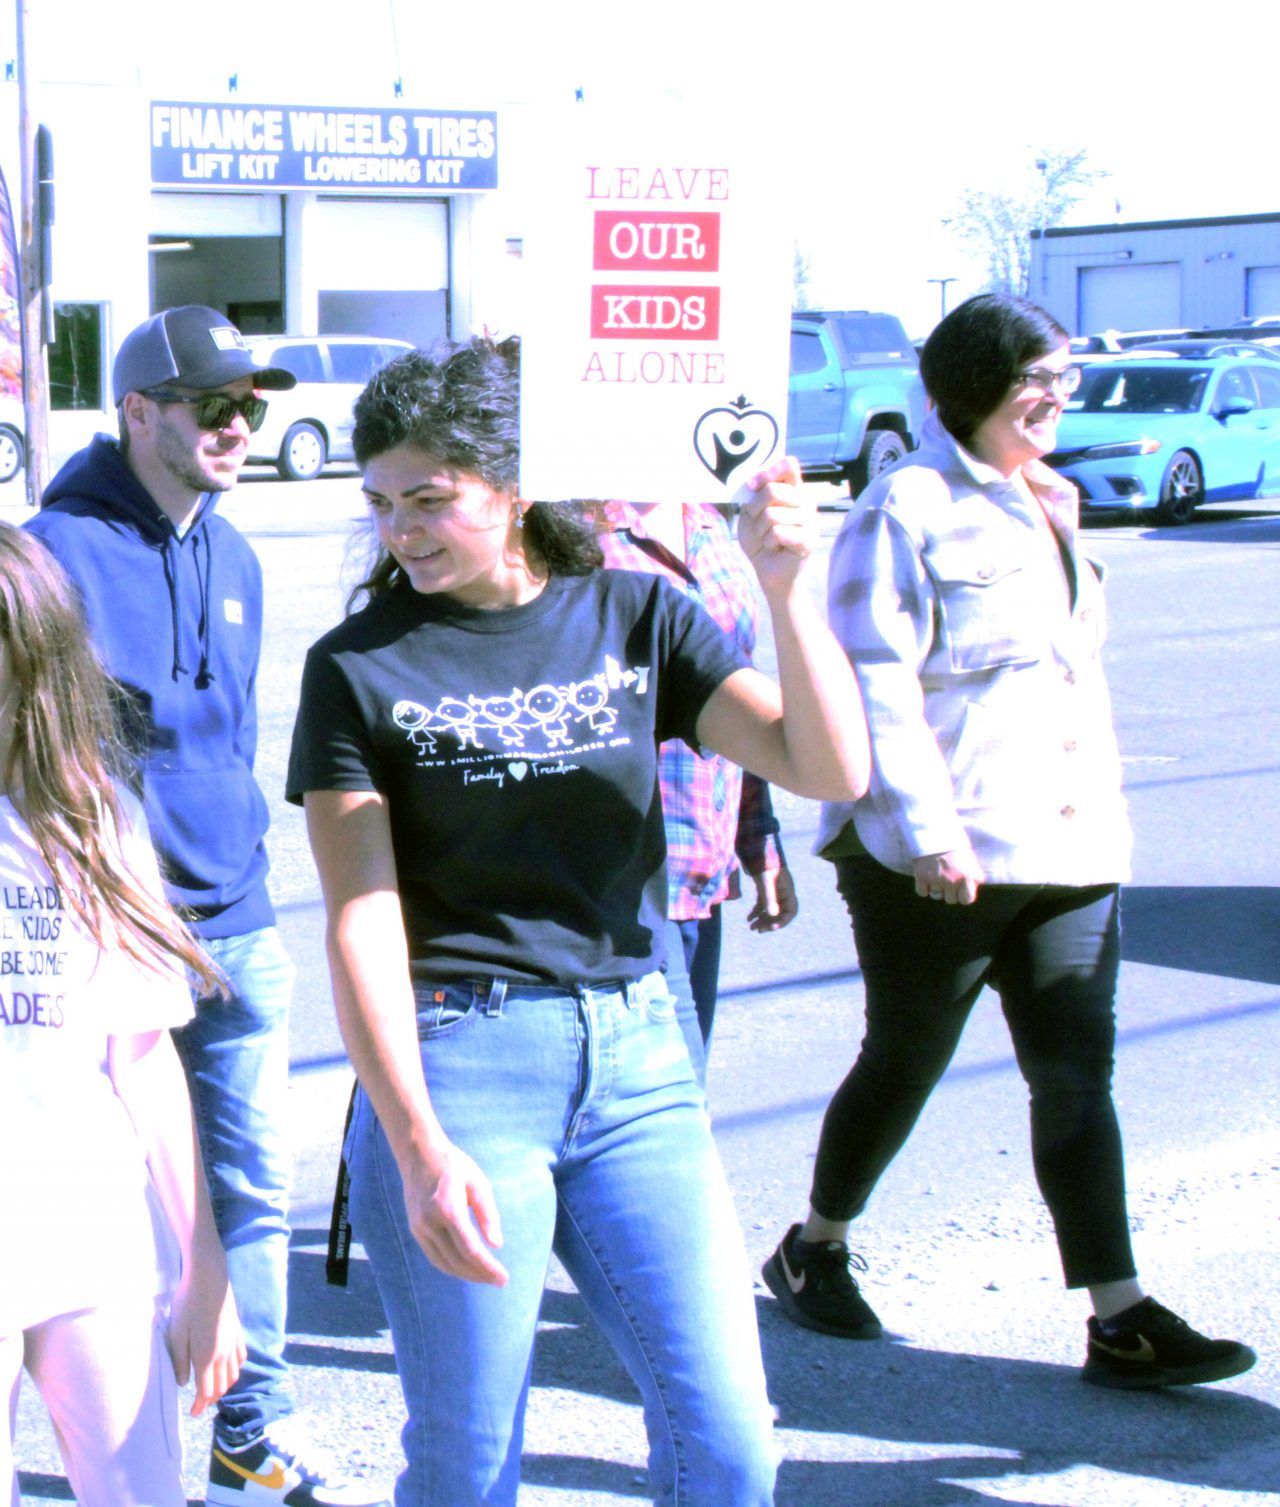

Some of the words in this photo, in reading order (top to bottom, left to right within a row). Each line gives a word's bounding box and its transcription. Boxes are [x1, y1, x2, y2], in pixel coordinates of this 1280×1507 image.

[152, 106, 283, 151] FINANCE
[289, 111, 407, 156] WHEELS
[413, 116, 495, 158] TIRES
[182, 153, 233, 179] LIFT
[239, 154, 280, 180] KIT
[304, 156, 421, 183] LOWERING
[426, 159, 464, 184] KIT
[585, 166, 730, 200] LEAVE
[609, 221, 706, 260] OUR
[603, 295, 706, 331] KIDS
[581, 351, 725, 384] ALONE
[463, 767, 504, 788] Family
[531, 759, 580, 778] Freedom
[22, 915, 63, 942] KIDS
[0, 951, 68, 976] BECOME
